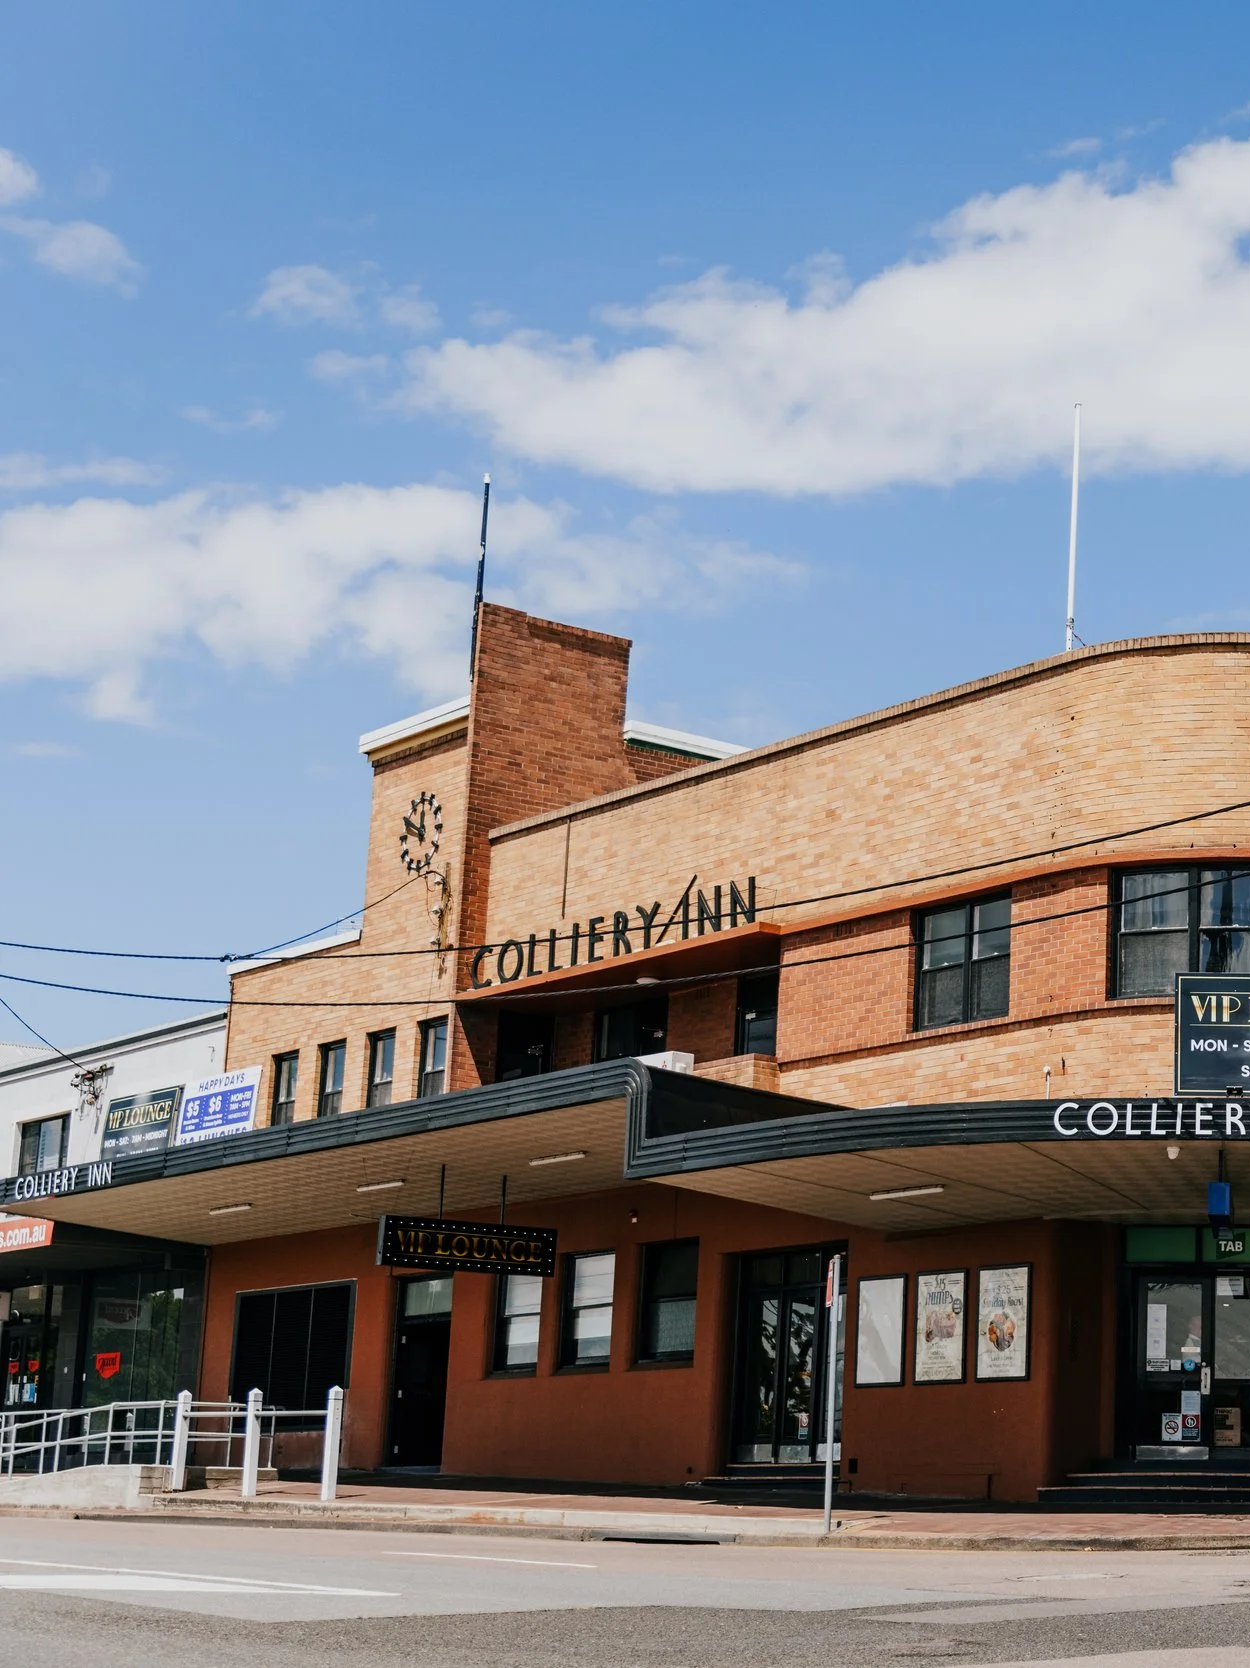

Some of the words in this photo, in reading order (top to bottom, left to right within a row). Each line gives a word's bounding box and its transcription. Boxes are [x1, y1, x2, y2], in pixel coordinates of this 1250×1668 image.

[471, 901, 662, 990] COLLIERY
[681, 875, 757, 941] INN
[1190, 995, 1242, 1023] VIP
[1190, 1039, 1228, 1052] MON
[199, 1078, 224, 1093] HAPPY
[223, 1072, 246, 1087] DAYS
[108, 1110, 125, 1130] VIP
[123, 1100, 173, 1126] LOUNGE
[186, 1099, 201, 1118] $5
[208, 1095, 222, 1115] $6
[15, 1167, 79, 1200] COLLIERY
[87, 1161, 113, 1187] INN
[397, 1230, 432, 1253] VIP
[434, 1234, 543, 1263] LOUNGE
[1219, 1240, 1243, 1252] TAB
